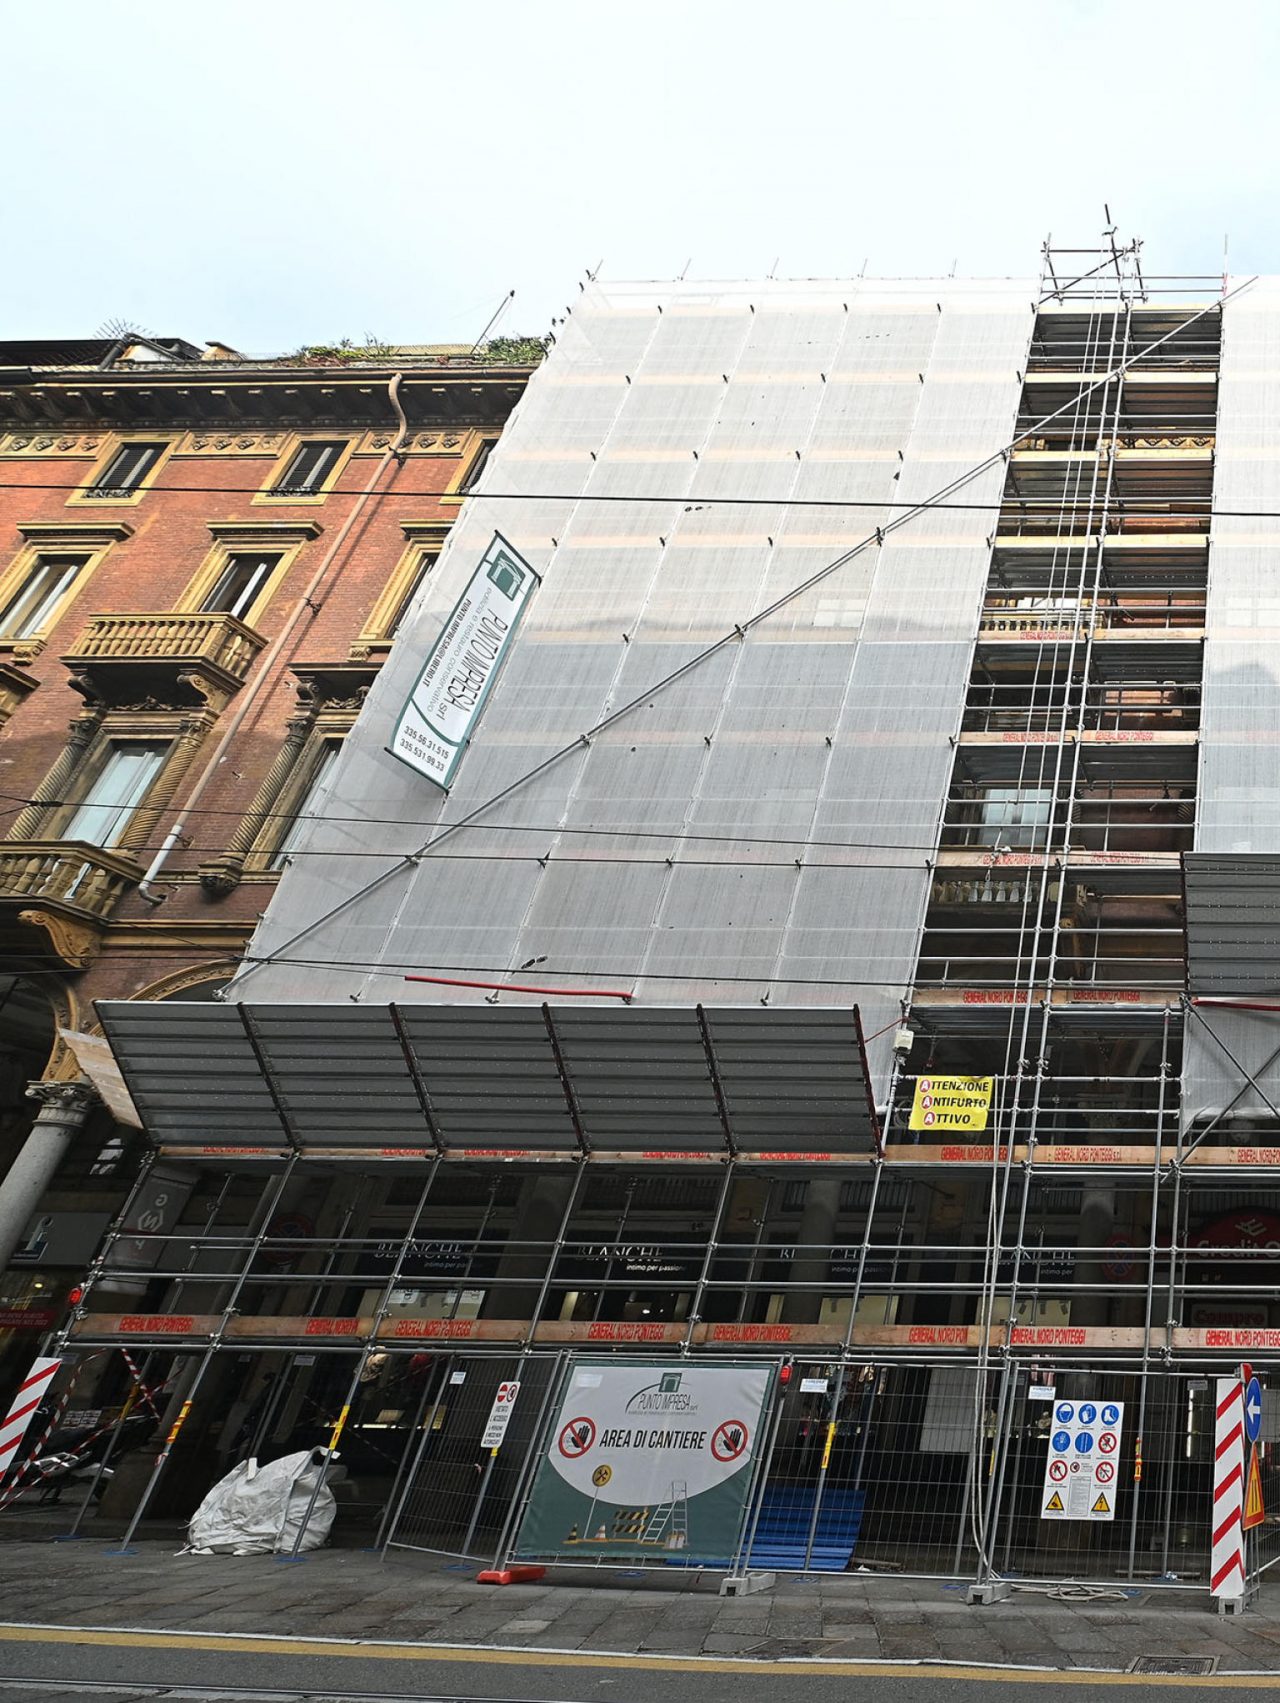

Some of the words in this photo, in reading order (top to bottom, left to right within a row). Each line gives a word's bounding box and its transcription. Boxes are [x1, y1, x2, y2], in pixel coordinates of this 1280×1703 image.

[470, 609, 509, 660] PUNTO
[447, 649, 490, 713] IMPRESA
[436, 702, 448, 721] srl
[403, 725, 450, 760] 335.56.31.515
[399, 738, 446, 772] 335.531.99.33
[920, 1080, 989, 1092] ATTENZIONE
[922, 1096, 987, 1108] ANTIFURTO
[925, 1112, 971, 1124] ATTIVO
[626, 1263, 646, 1271] intimo
[646, 1265, 659, 1273] per
[908, 1327, 936, 1343] GENERAL
[937, 1327, 955, 1343] NORD
[1037, 1329, 1054, 1345] NORD
[1055, 1329, 1087, 1345] PONTEGGI
[1206, 1330, 1233, 1346] GENERAL
[1235, 1330, 1252, 1346] NORD
[637, 1393, 662, 1410] PUNTO
[661, 1394, 691, 1411] IMPRESA
[599, 1429, 632, 1448] AREA
[633, 1430, 647, 1448] DI
[647, 1430, 707, 1450] CANTIERE
